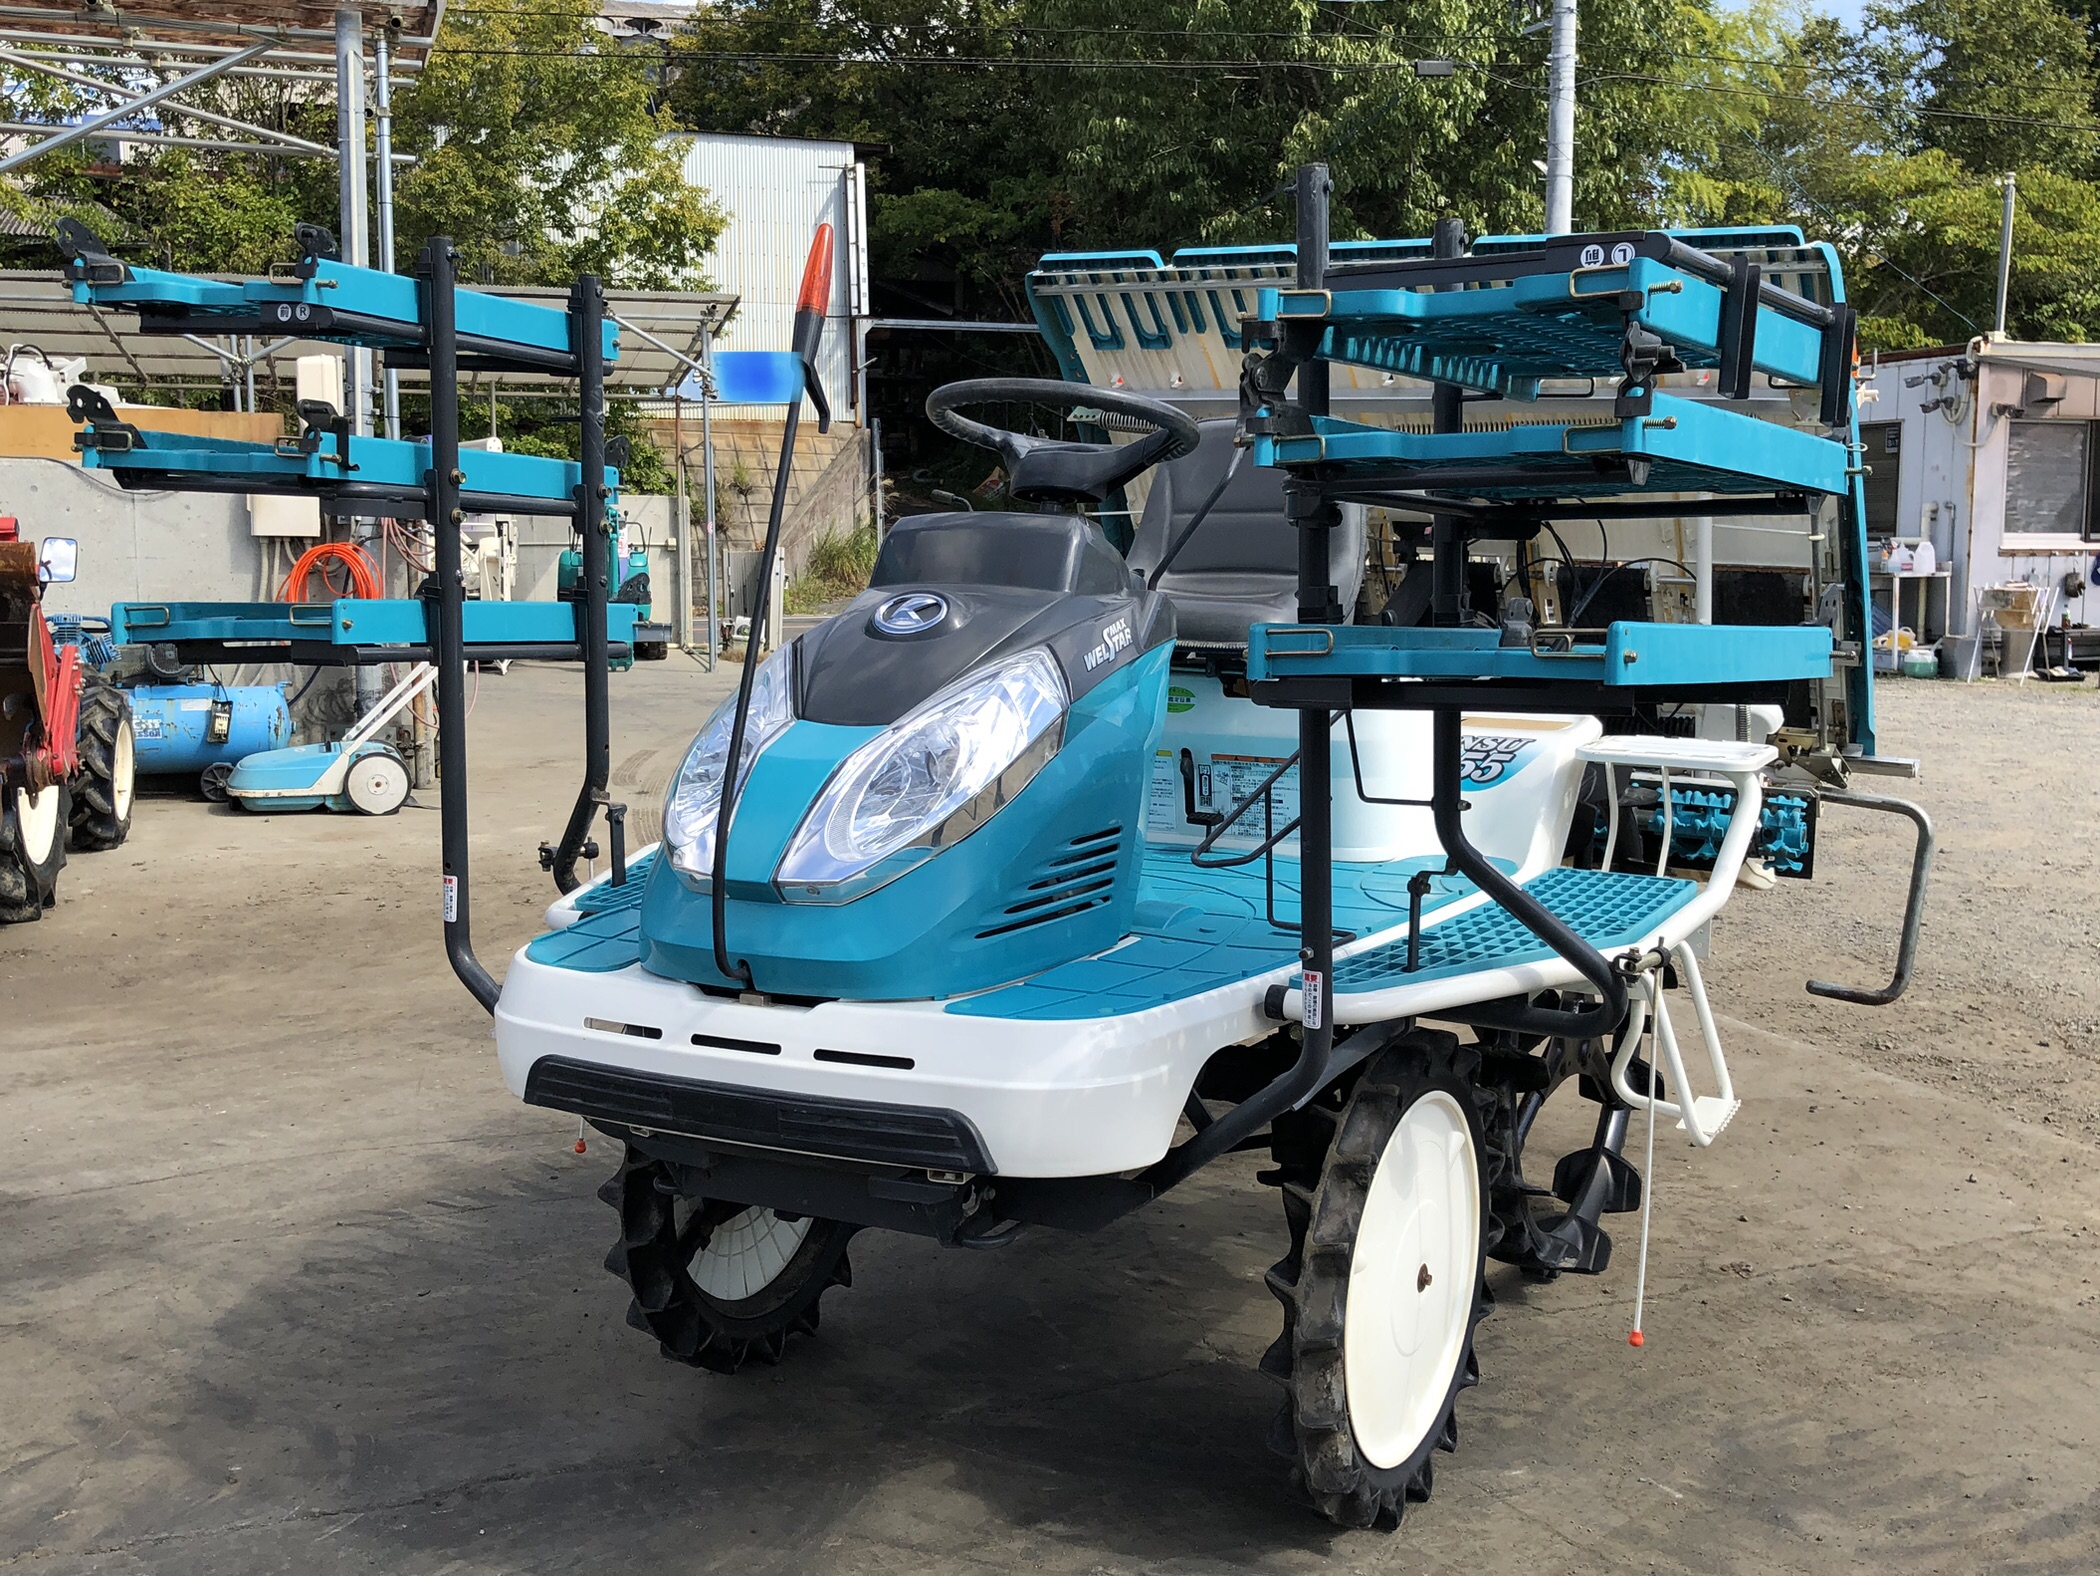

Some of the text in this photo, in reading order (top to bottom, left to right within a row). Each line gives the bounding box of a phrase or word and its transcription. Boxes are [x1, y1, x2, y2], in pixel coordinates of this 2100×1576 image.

[1617, 248, 1628, 262] L
[299, 306, 307, 317] R
[1109, 617, 1128, 637] MAX
[1083, 626, 1134, 672] WELSTAR
